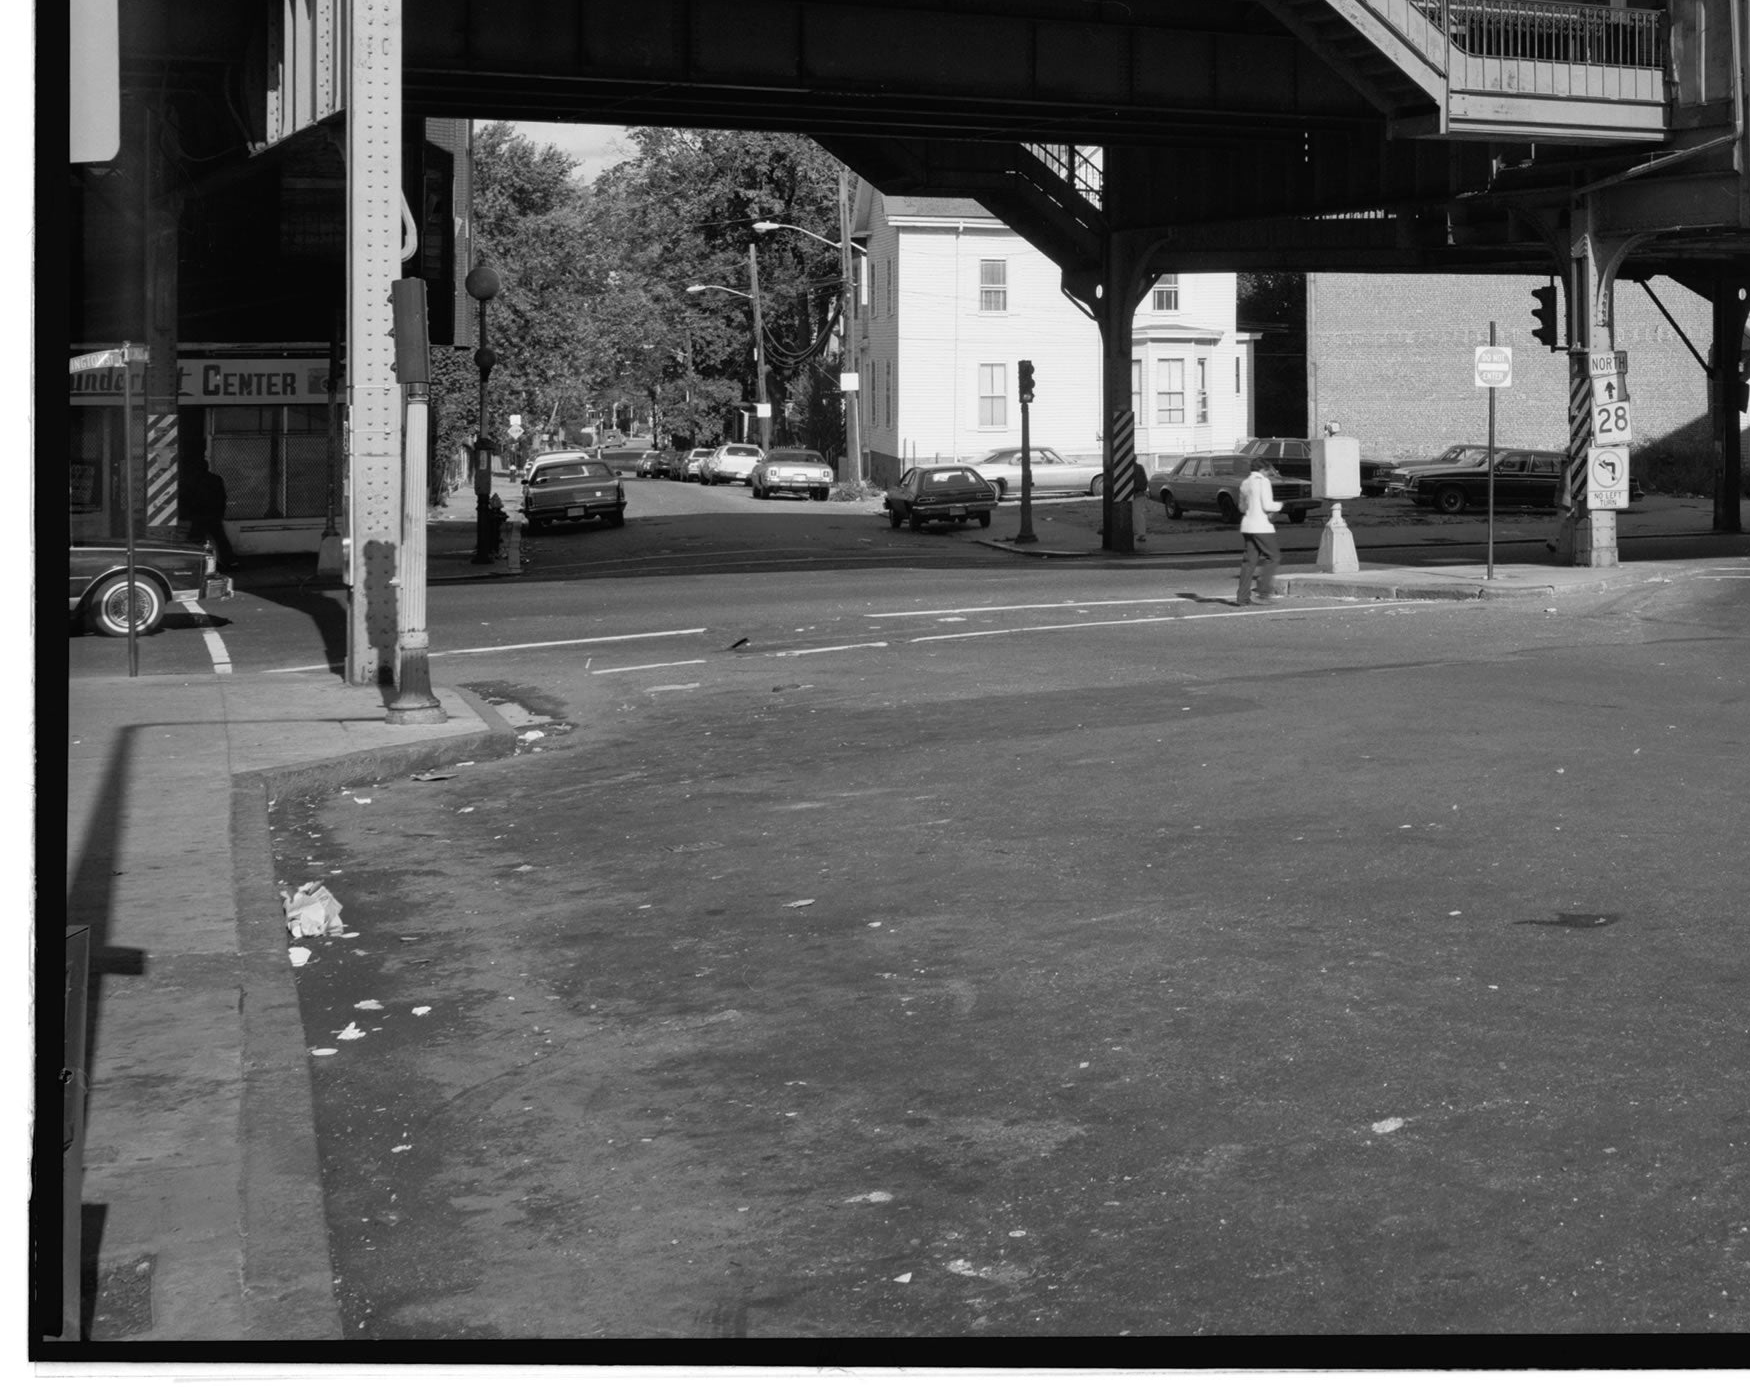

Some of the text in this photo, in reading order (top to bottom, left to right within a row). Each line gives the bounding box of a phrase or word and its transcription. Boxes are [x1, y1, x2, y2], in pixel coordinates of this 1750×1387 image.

[1482, 353, 1505, 362] DO NOT
[1591, 355, 1625, 371] NORTH
[202, 364, 297, 396] CENTER
[1481, 372, 1504, 381] ENTER
[1597, 406, 1628, 434] 28
[1594, 491, 1622, 501] NO LEFT
[1600, 499, 1617, 507] TURN
